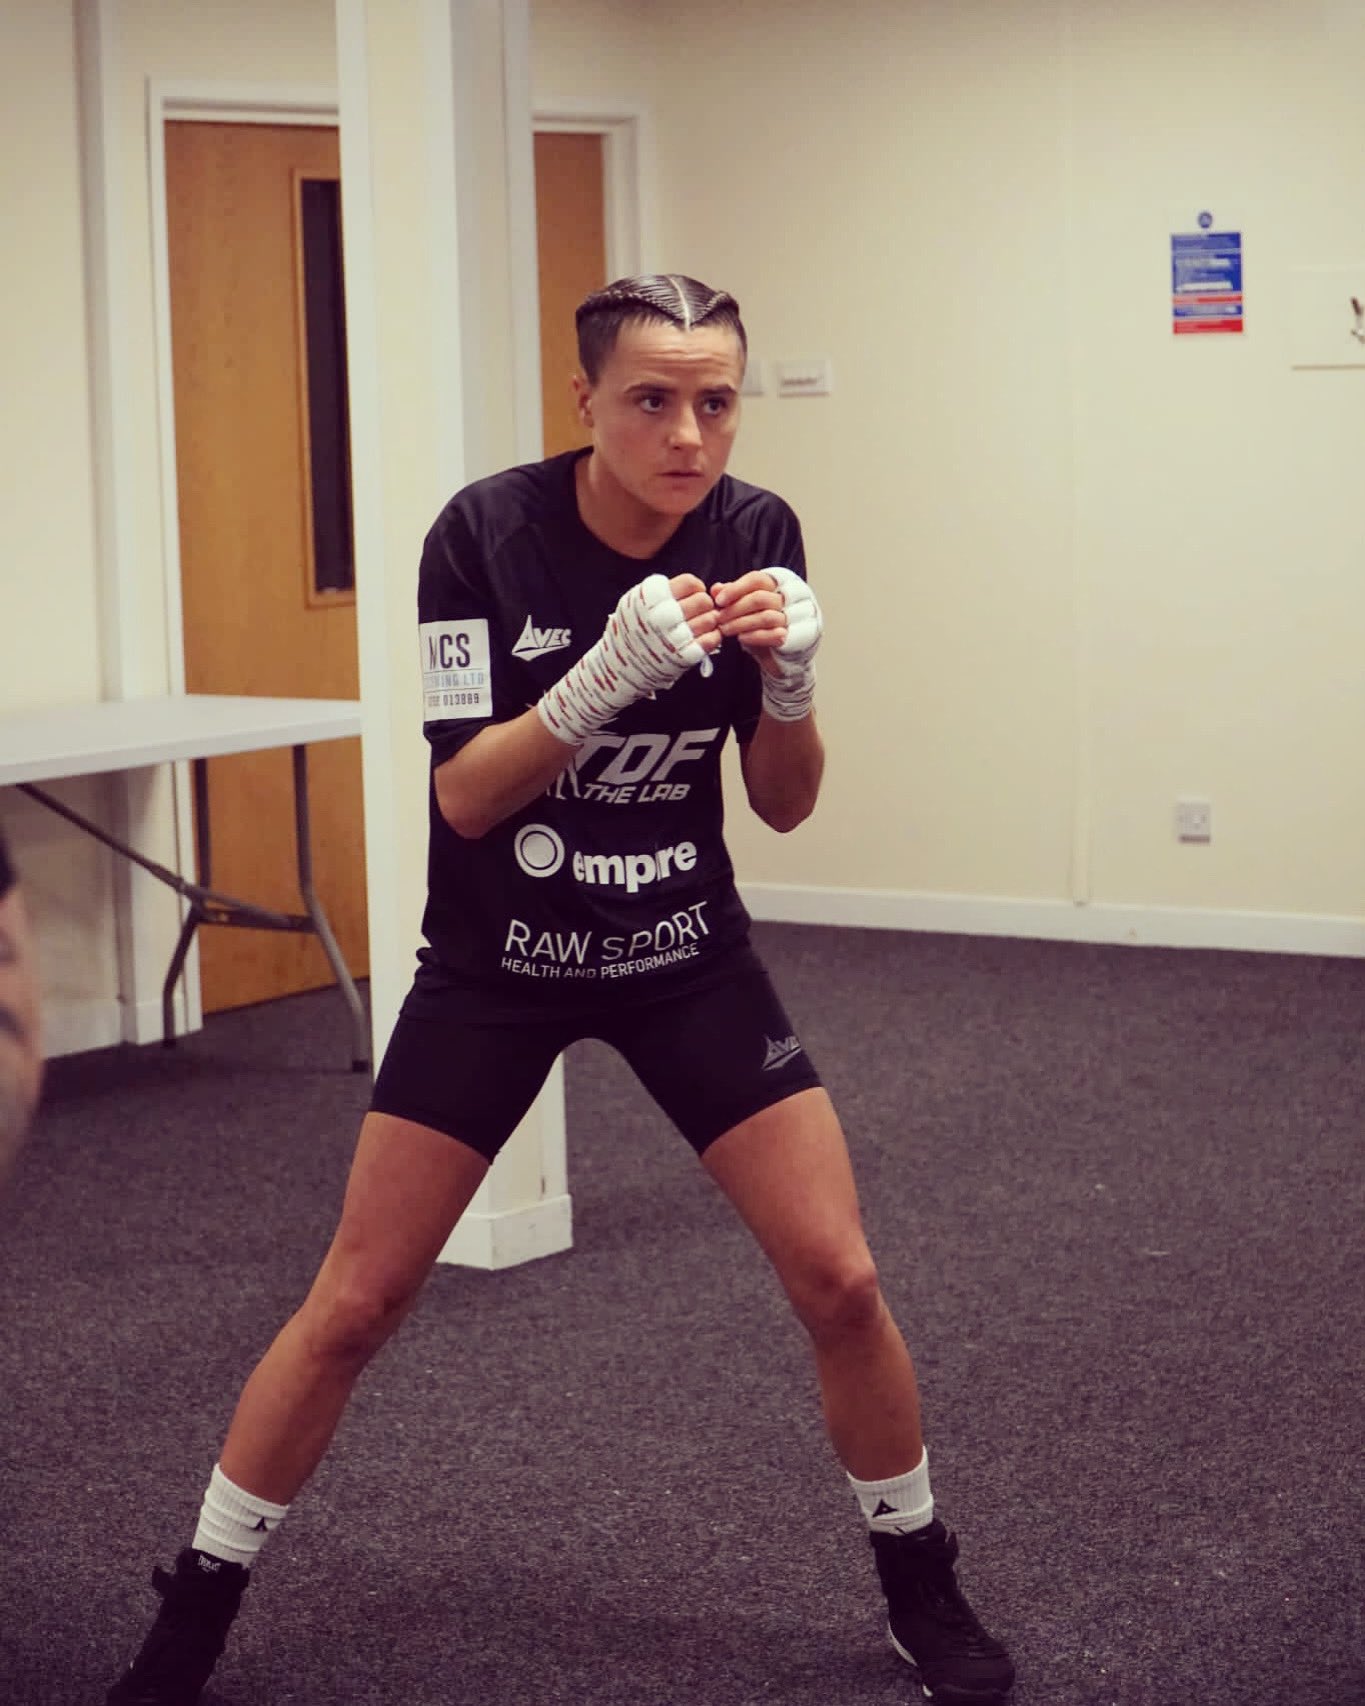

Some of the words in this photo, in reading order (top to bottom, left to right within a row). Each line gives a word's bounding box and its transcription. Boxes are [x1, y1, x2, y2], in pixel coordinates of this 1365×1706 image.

[512, 615, 572, 655] AVEC
[583, 783, 636, 804] THE
[637, 783, 691, 802] LAB
[572, 841, 697, 893] empre
[505, 919, 592, 965] RAW
[601, 901, 710, 961] SPORT
[501, 957, 560, 978] HEALTH
[564, 967, 597, 979] AND
[601, 943, 700, 979] PERFORMANCE
